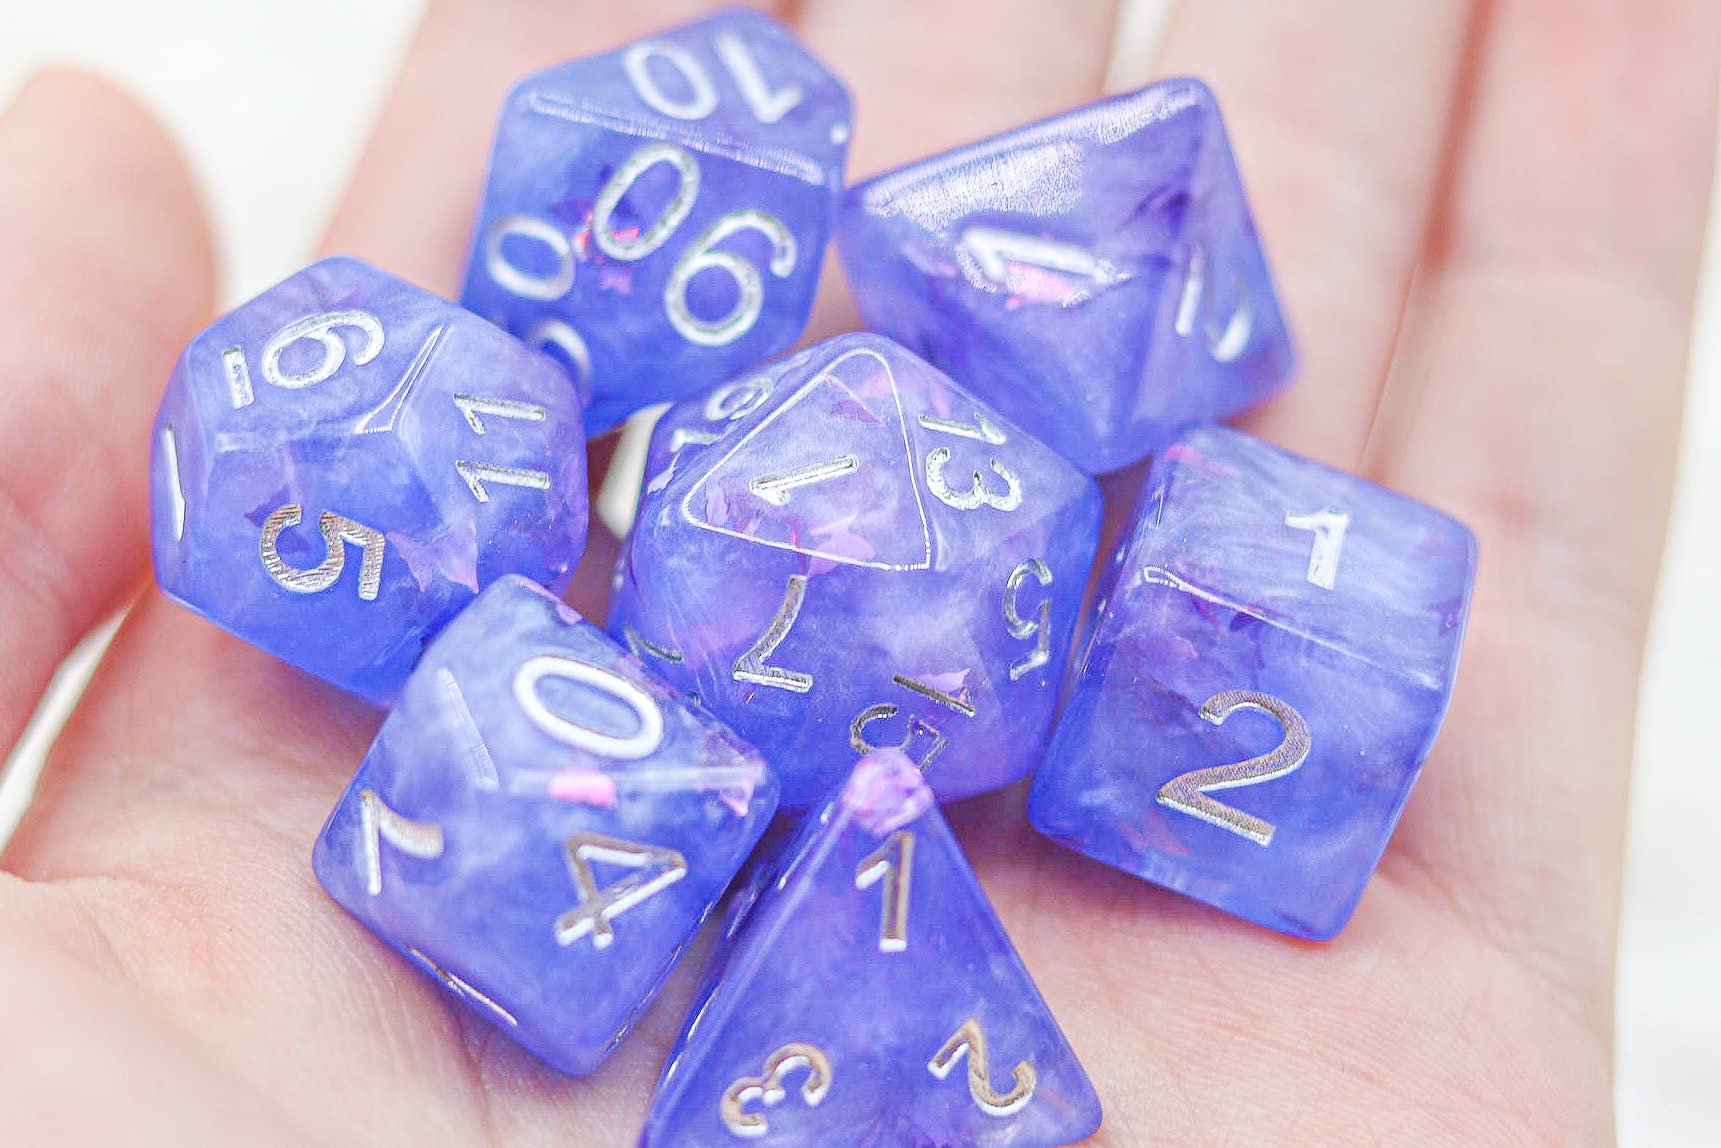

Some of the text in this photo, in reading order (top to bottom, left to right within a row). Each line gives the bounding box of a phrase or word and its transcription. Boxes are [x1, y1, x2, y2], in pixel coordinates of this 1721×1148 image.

[622, 31, 803, 124] 10
[960, 224, 1102, 281] 1
[452, 391, 551, 503] 11
[747, 454, 860, 506] 1
[917, 411, 1022, 512] 13
[259, 503, 386, 601] 5
[1284, 507, 1350, 590] 1
[1003, 557, 1054, 681] 5
[512, 654, 664, 760] 0
[1156, 690, 1312, 848] 2
[554, 829, 688, 949] 4
[855, 830, 916, 953] 1
[720, 1041, 833, 1138] 3
[926, 1016, 1037, 1117] 2
